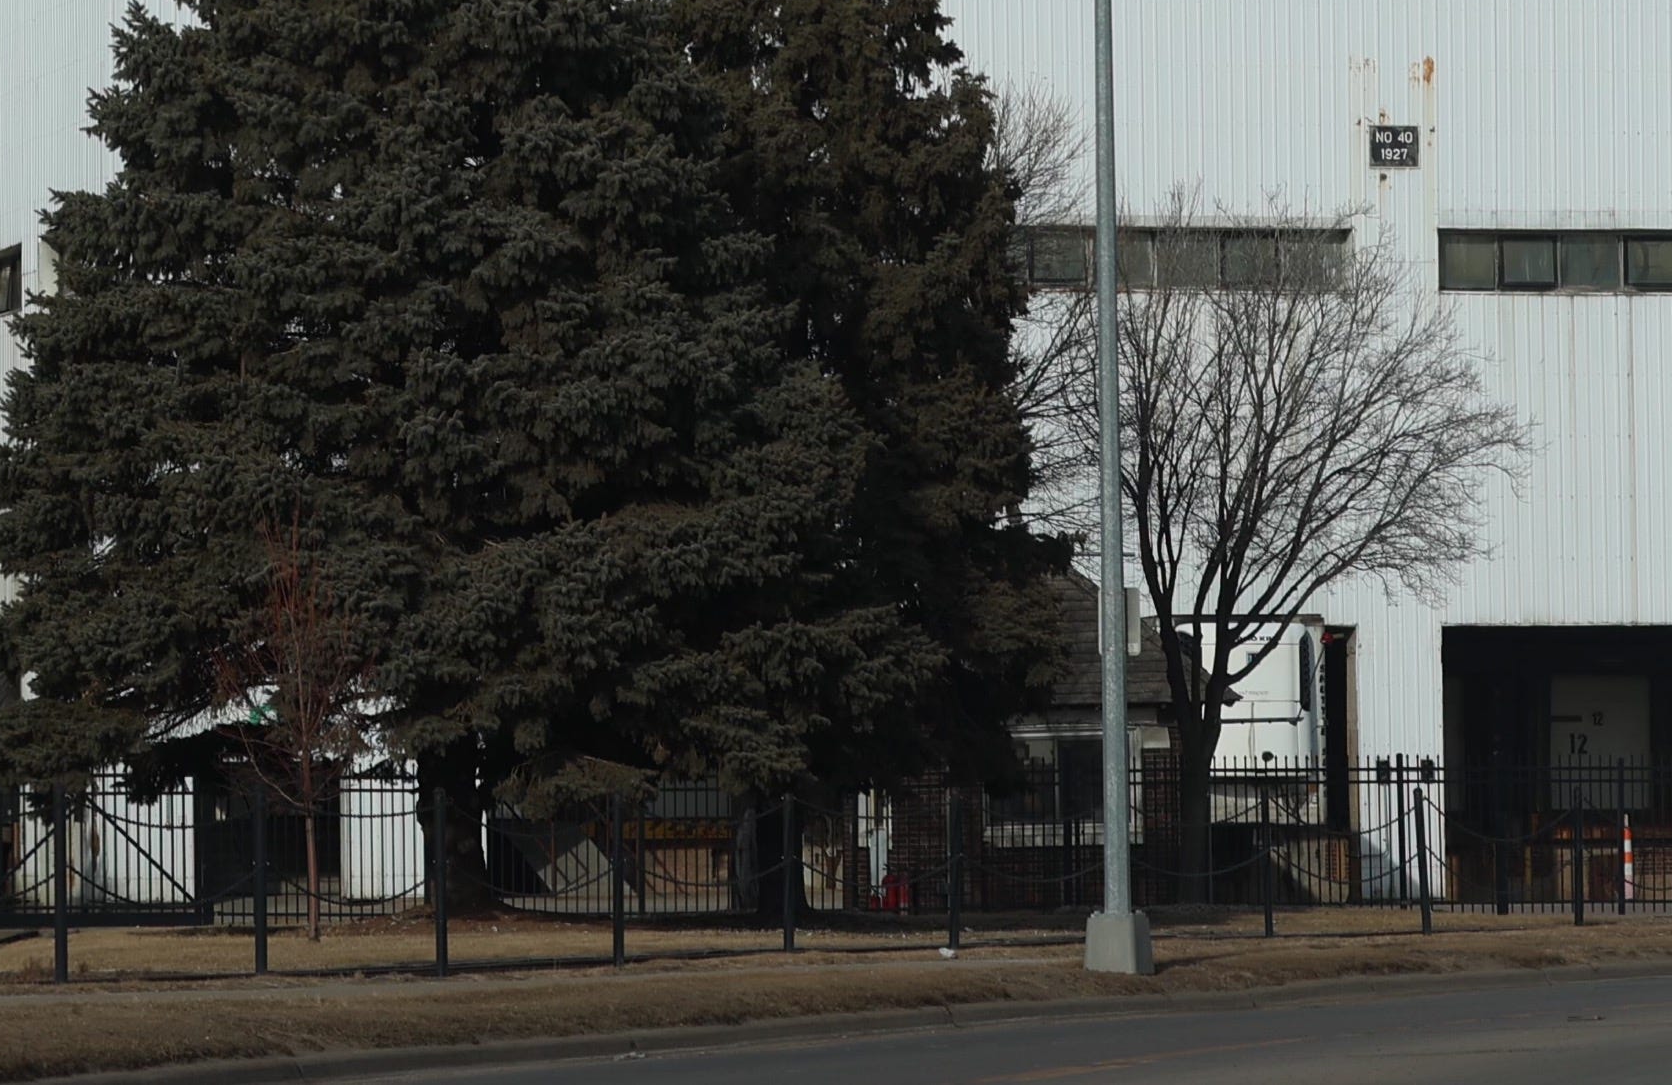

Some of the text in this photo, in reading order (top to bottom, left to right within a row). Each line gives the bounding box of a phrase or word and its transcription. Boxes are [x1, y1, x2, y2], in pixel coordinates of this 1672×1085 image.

[1375, 131, 1413, 144] NO 40
[1381, 148, 1408, 161] 1927
[1569, 732, 1588, 755] 12
